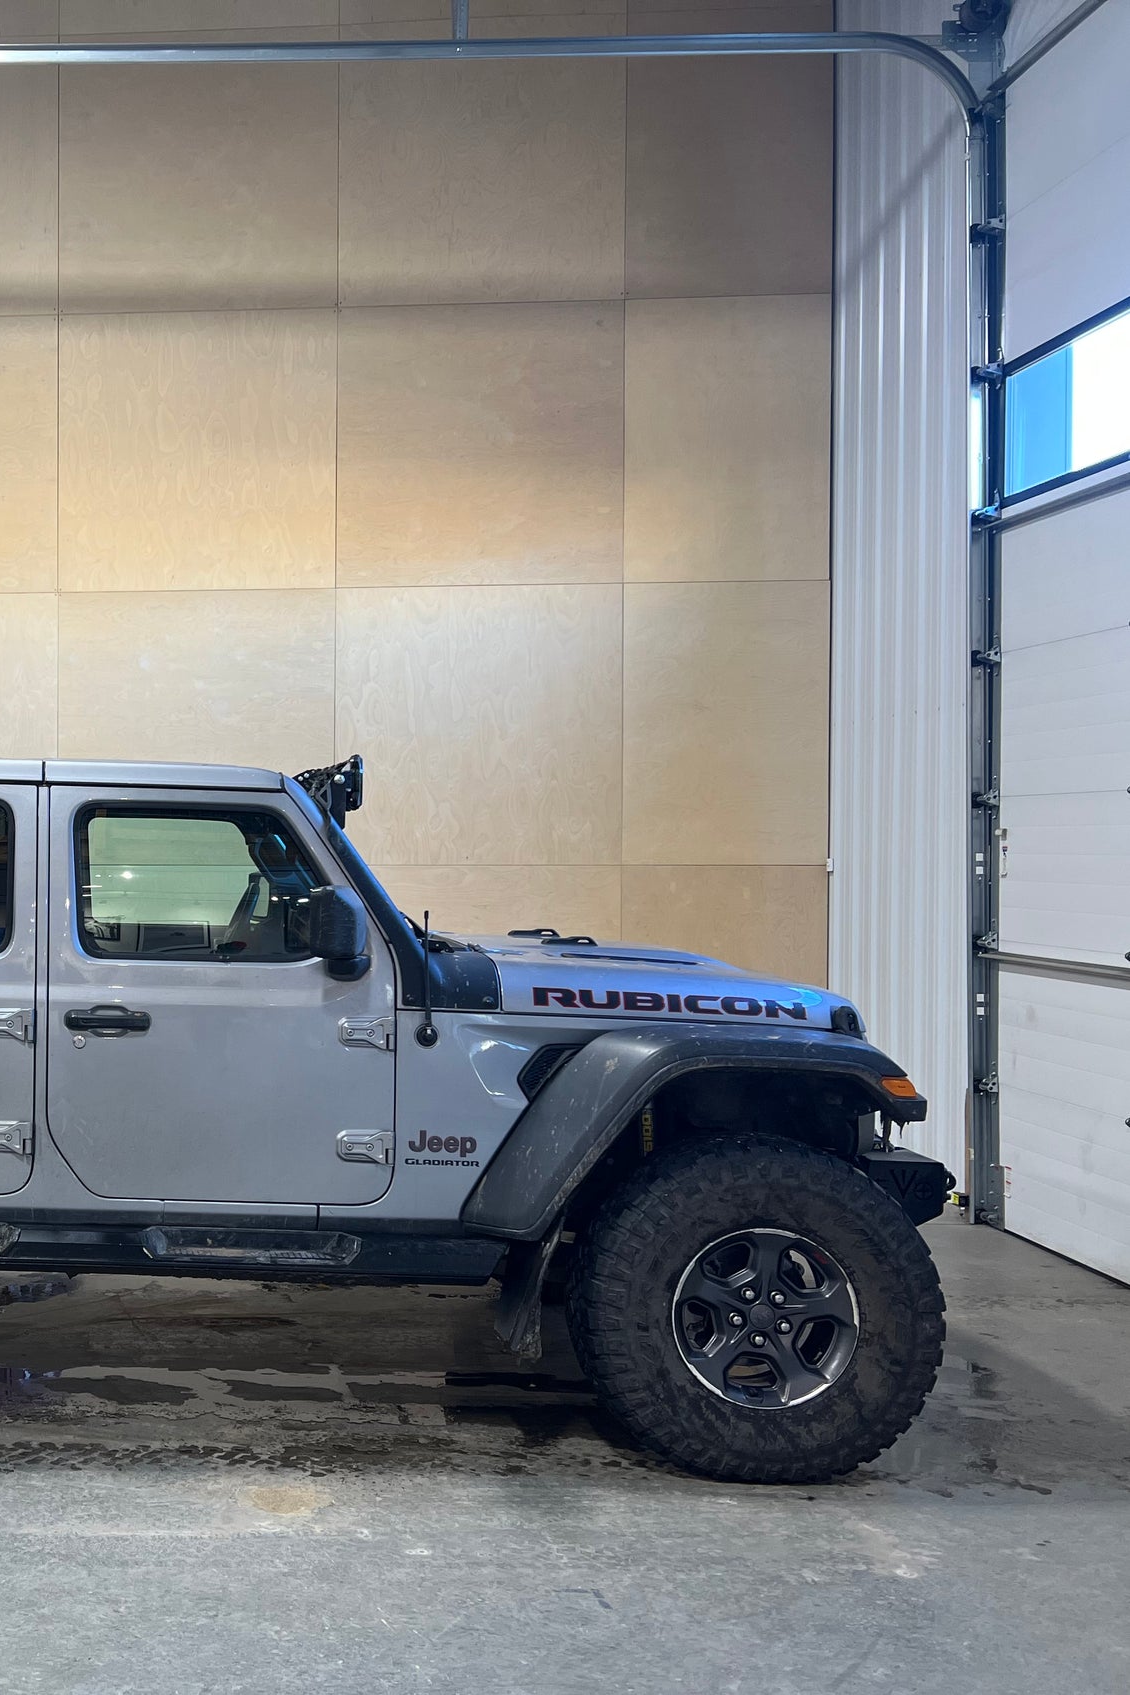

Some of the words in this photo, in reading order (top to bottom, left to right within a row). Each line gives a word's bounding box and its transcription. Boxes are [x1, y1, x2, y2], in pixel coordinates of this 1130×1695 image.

[532, 986, 808, 1020] RUBICON
[408, 1130, 477, 1157] Jeep
[405, 1158, 480, 1167] GLADIATOR
